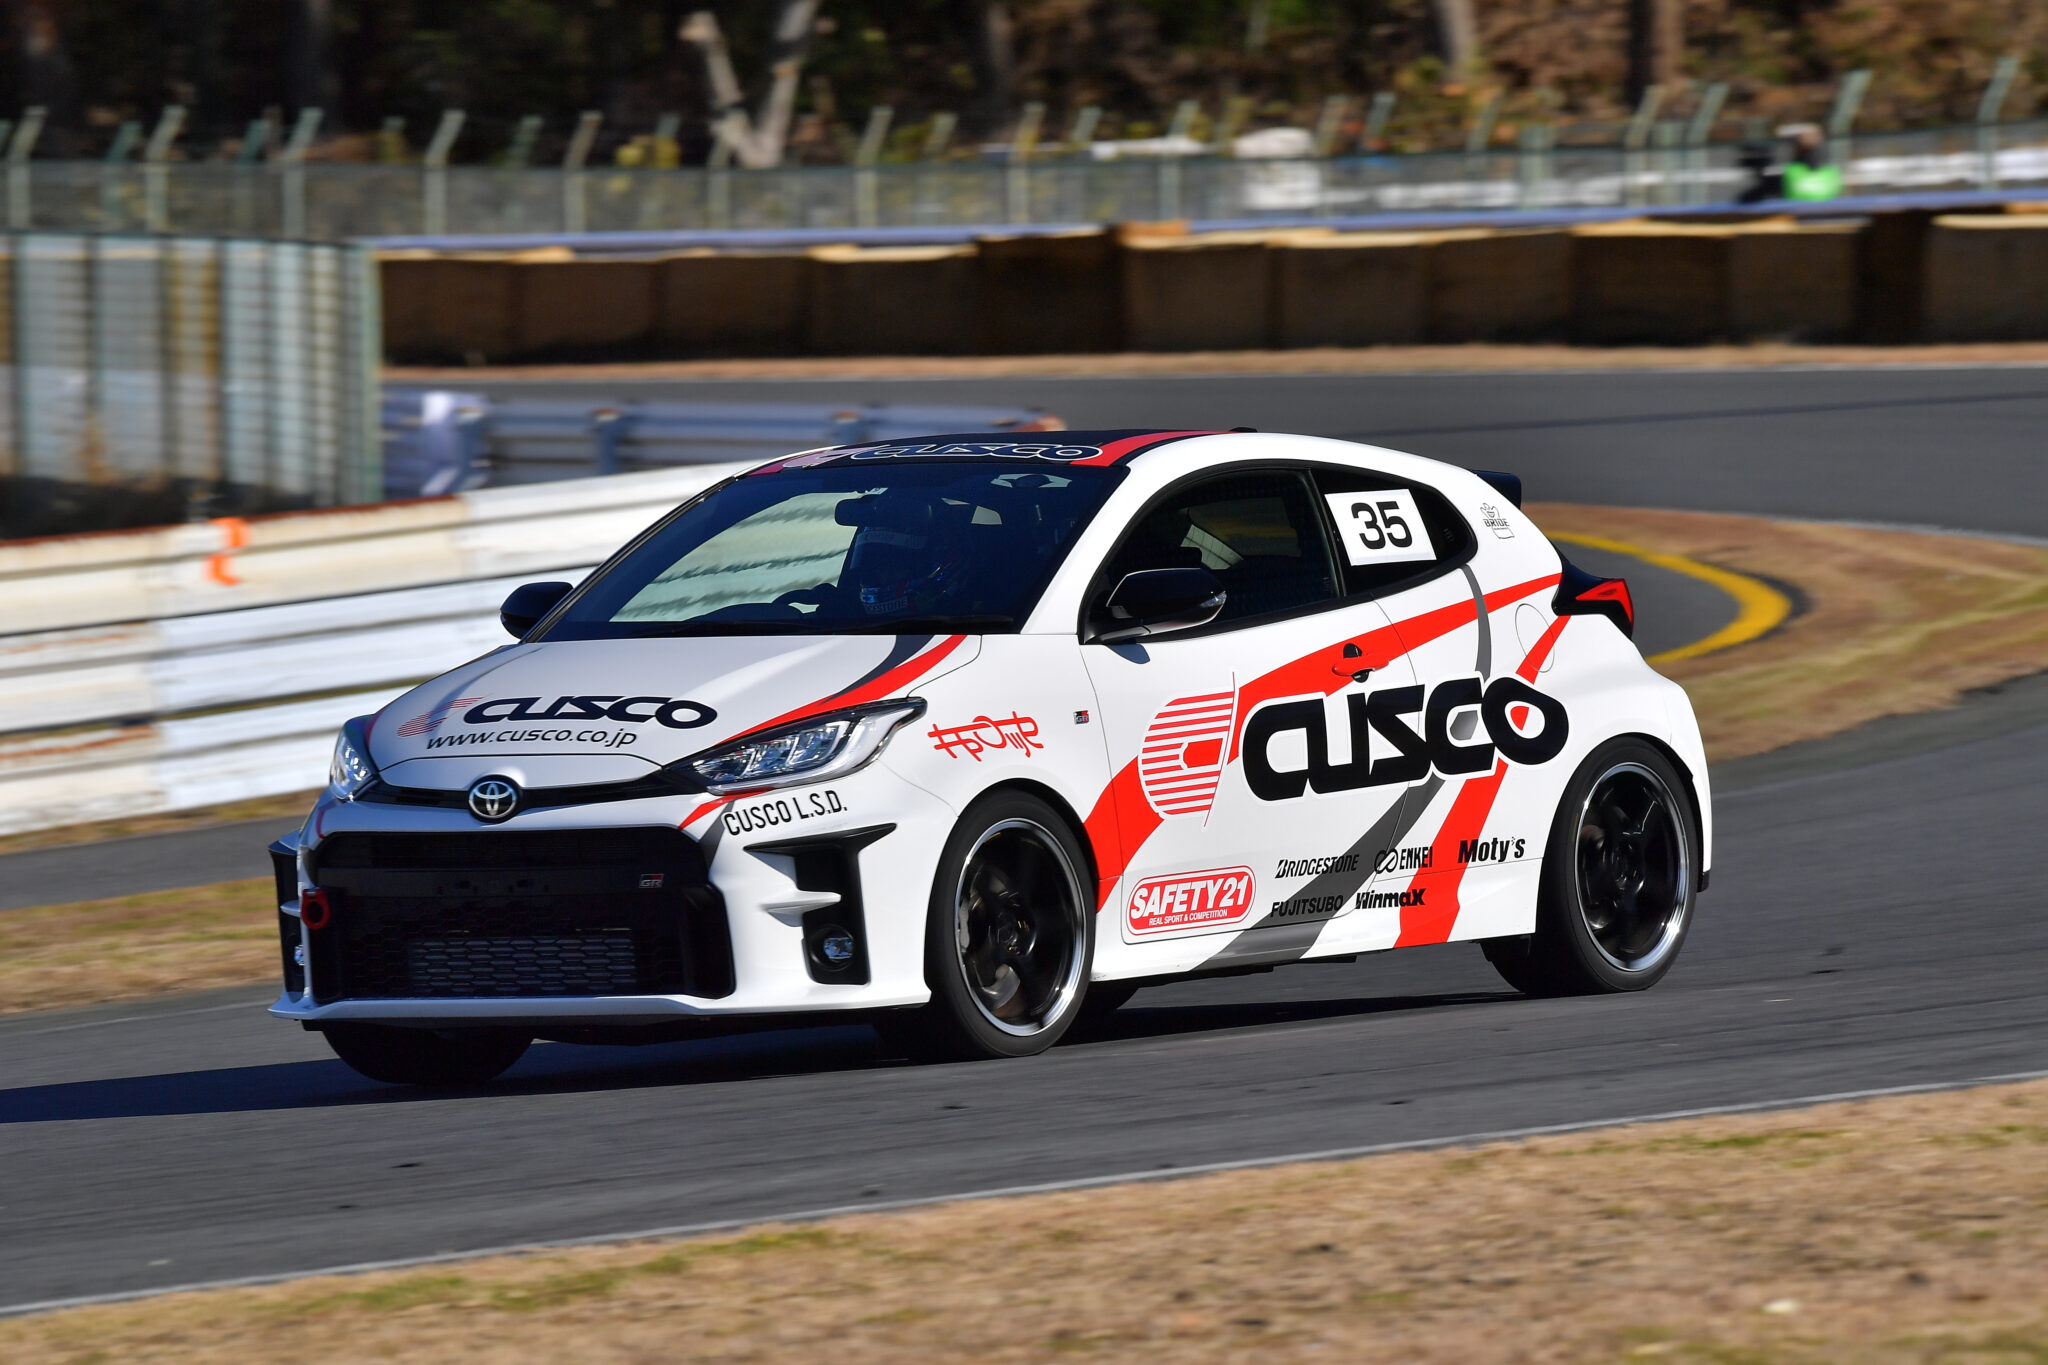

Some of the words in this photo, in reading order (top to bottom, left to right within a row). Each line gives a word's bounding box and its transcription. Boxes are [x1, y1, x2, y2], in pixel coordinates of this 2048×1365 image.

[851, 443, 1103, 460] CUSCO
[1351, 501, 1412, 550] 35
[1483, 518, 1510, 527] BRIDE
[464, 696, 717, 729] CUSCO
[426, 708, 637, 749] www.cusco.co.jp
[1242, 676, 1569, 801] CUSCO
[724, 800, 791, 836] CUSCO
[792, 790, 847, 819] L.S.D.
[1400, 846, 1432, 870] ENKEI
[1458, 837, 1525, 863] Moty's
[1275, 854, 1359, 879] BRIDGESTONE
[640, 876, 664, 889] GR
[1149, 917, 1163, 926] REAL
[1164, 914, 1183, 924] SPORT
[1189, 909, 1228, 920] COMPETITION
[1271, 895, 1343, 917] FUJITSUBO
